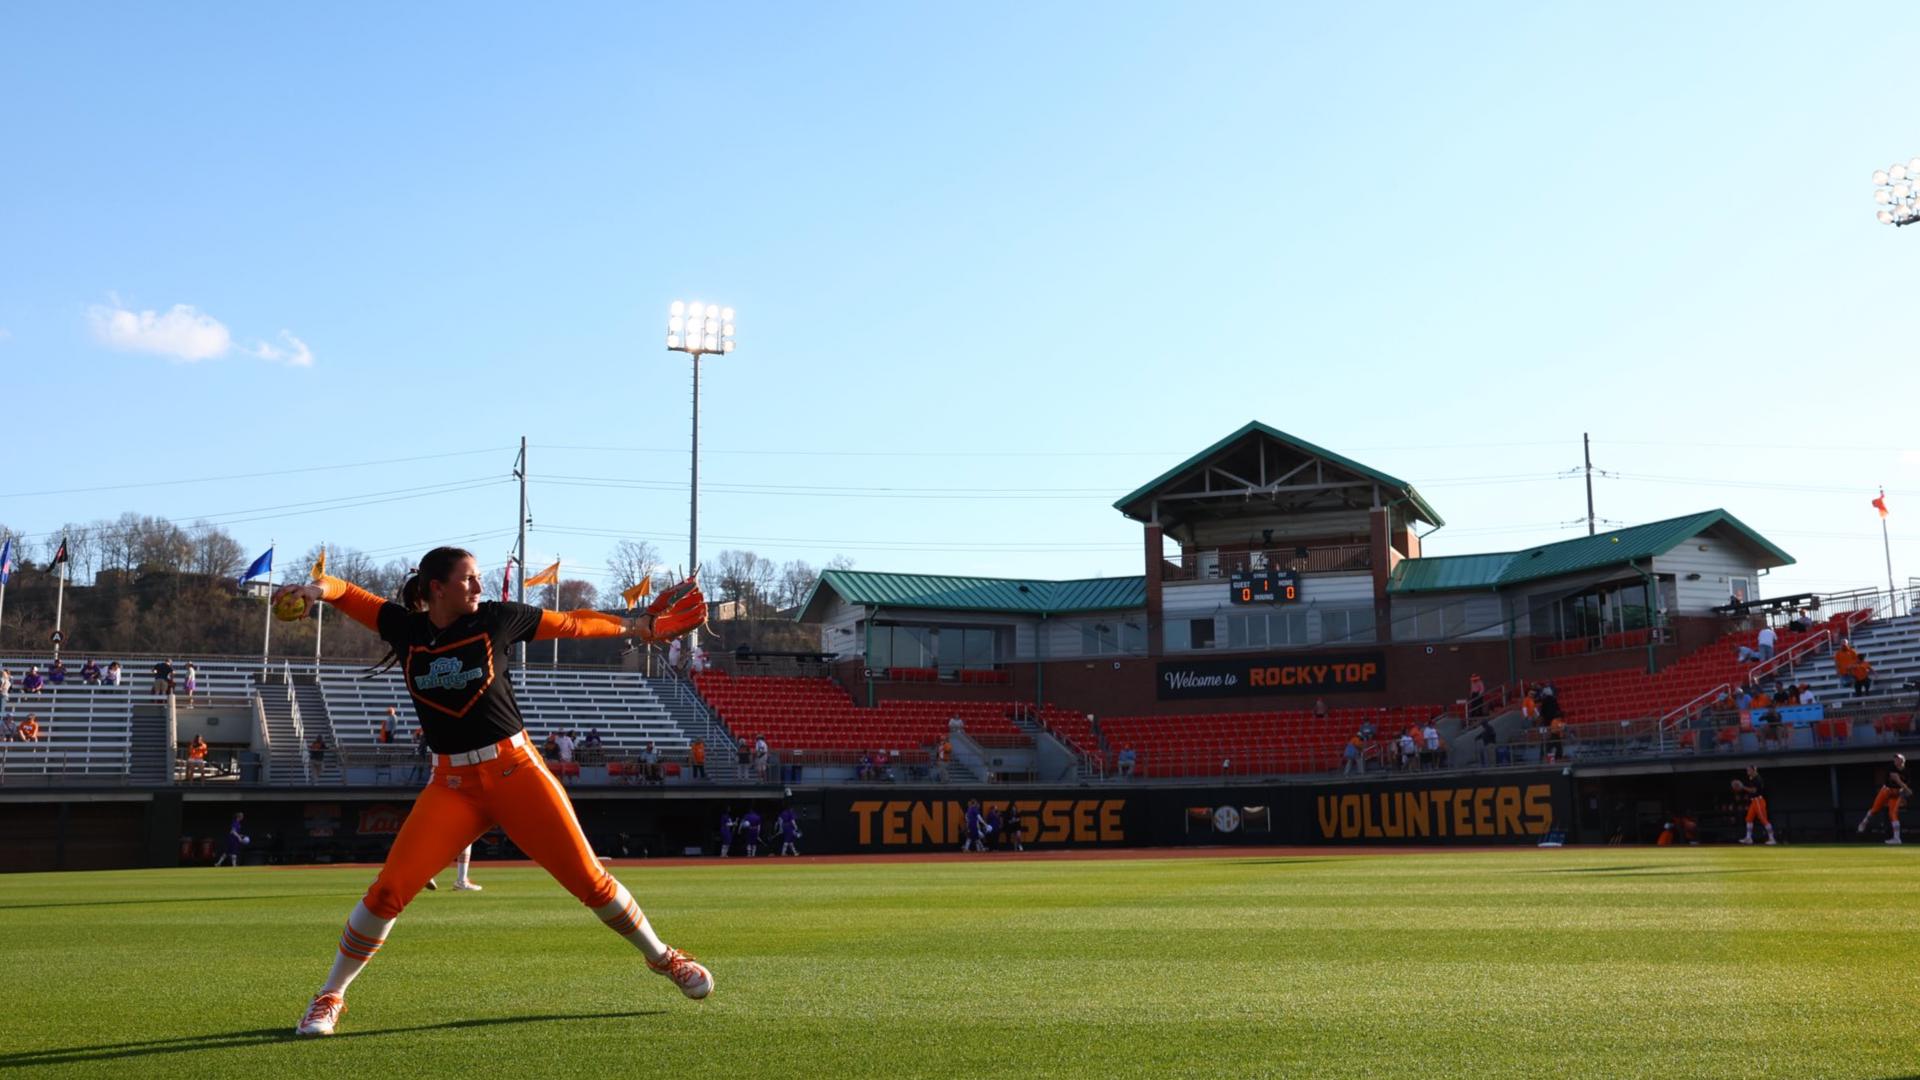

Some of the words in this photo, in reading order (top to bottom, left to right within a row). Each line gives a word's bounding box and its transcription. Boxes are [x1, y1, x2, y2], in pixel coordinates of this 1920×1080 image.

[1264, 580, 1269, 592] 1
[1286, 586, 1295, 599] 0
[1242, 588, 1251, 601] 0
[429, 656, 464, 676] Lady
[1164, 671, 1222, 690] Welcome
[1224, 674, 1238, 686] to
[1249, 664, 1328, 687] ROCKY
[1331, 662, 1377, 684] TOP
[1317, 784, 1553, 839] VOLUNTEERS
